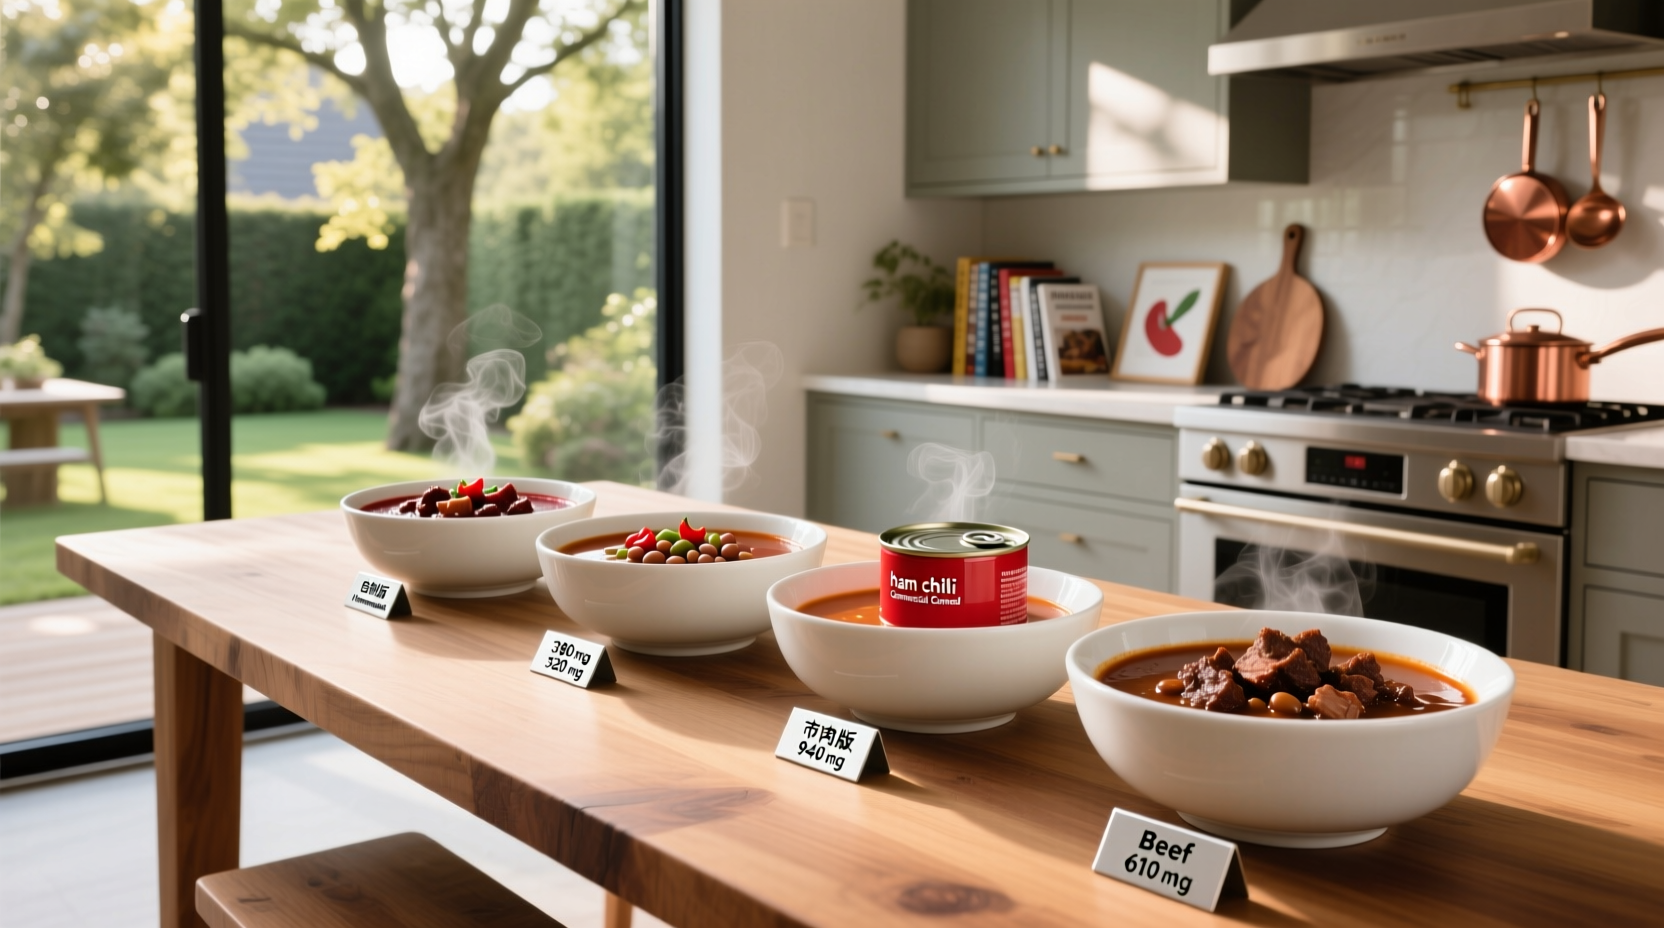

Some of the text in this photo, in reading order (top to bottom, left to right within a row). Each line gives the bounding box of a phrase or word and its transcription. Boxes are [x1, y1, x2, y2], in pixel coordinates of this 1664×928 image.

[890, 570, 957, 595] ham chili
[545, 656, 568, 673] 320
[797, 741, 846, 772] 940 mg
[1138, 829, 1196, 864] Beef
[1124, 853, 1193, 897] 610 mg
